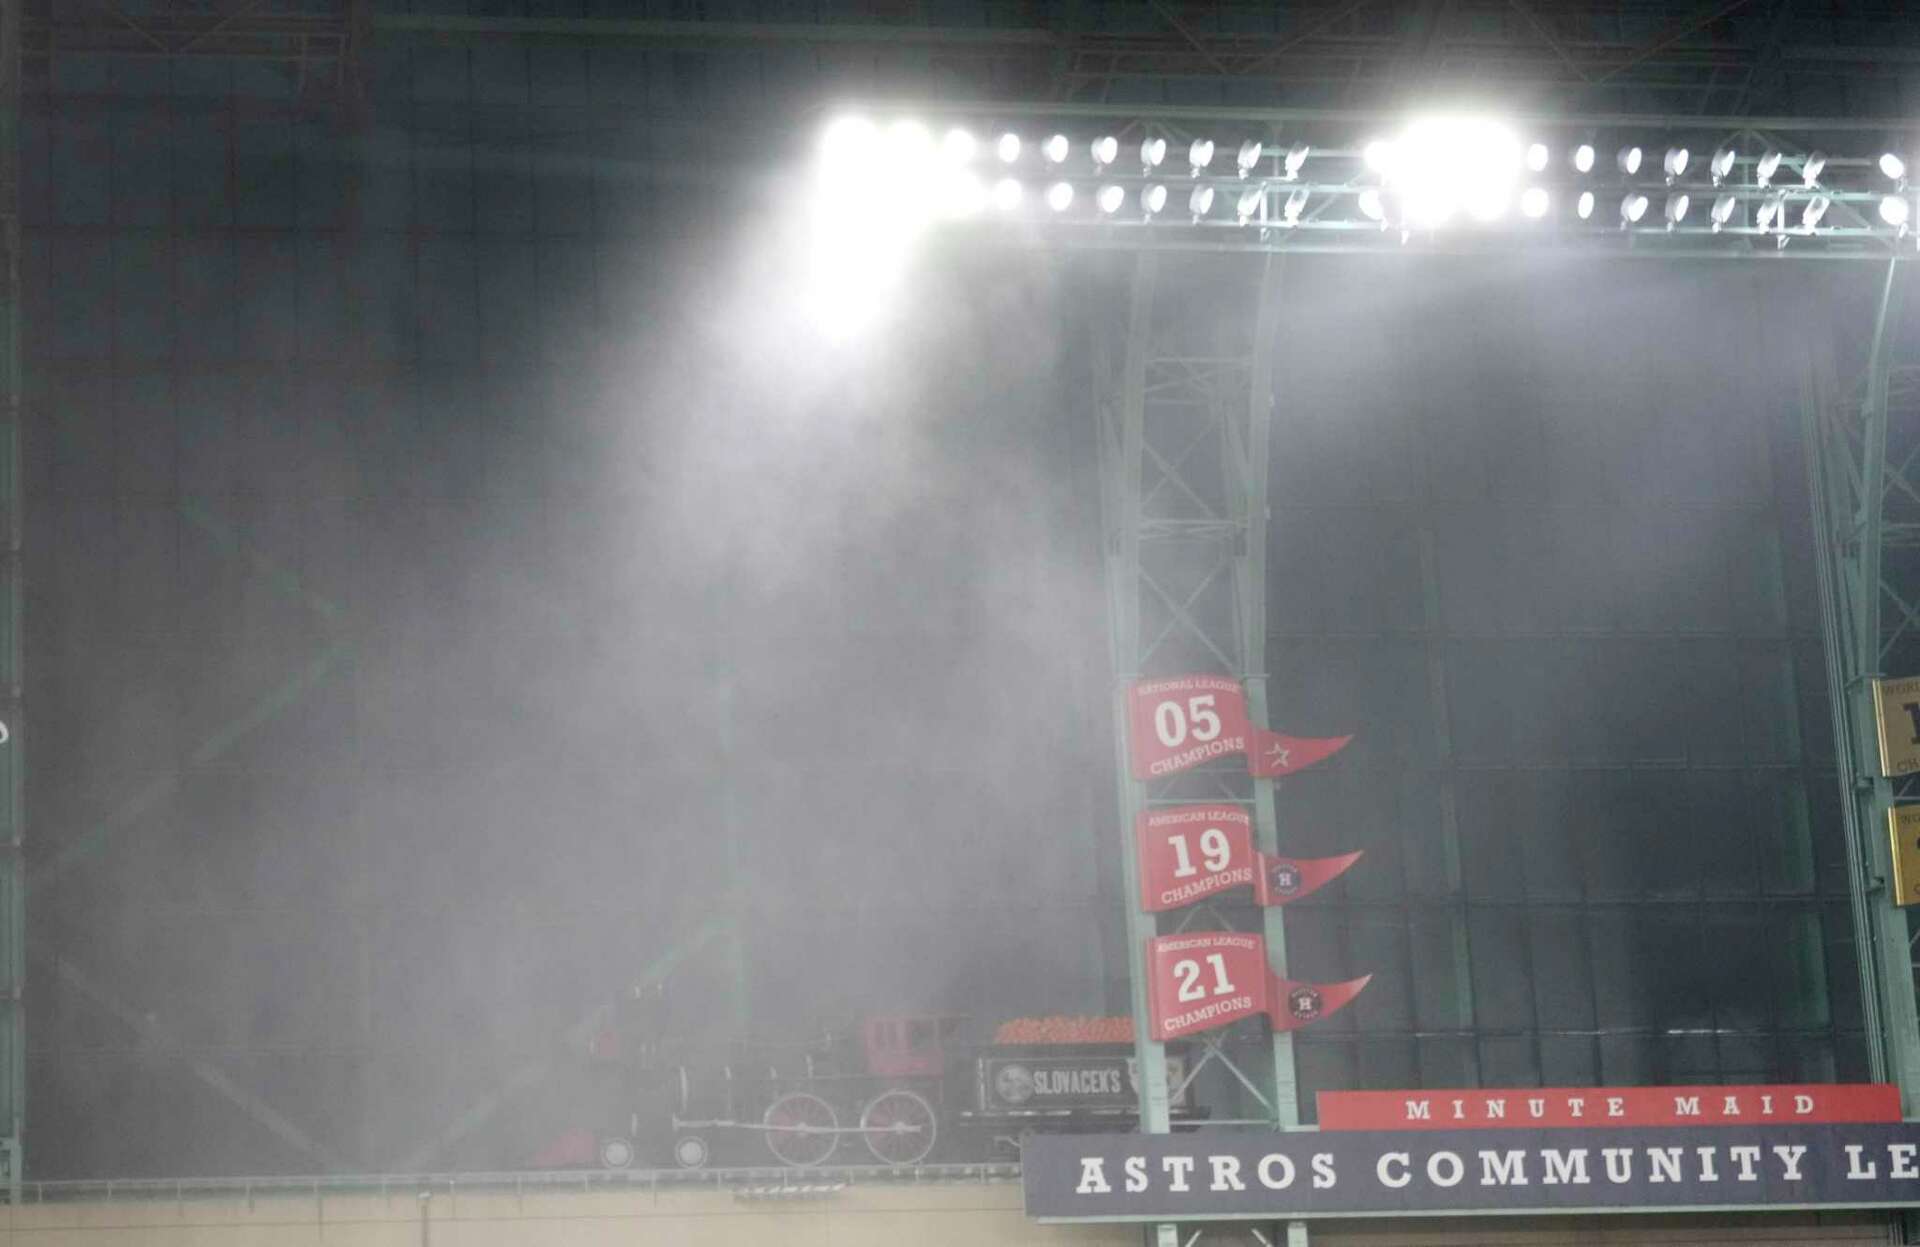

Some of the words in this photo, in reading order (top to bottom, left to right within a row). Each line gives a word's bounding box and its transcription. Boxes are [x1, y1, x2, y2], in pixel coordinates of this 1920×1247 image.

[1195, 679, 1241, 693] LEAGUE
[1154, 695, 1221, 748] 05
[1150, 737, 1245, 775] CHAMPIONS
[1148, 811, 1206, 826] AMERICAN
[1207, 810, 1249, 824] LEAGUE
[1167, 828, 1231, 878] 19
[1161, 867, 1252, 904] CHAMPIONS
[1156, 937, 1212, 952] AMERICAN
[1213, 936, 1255, 949] LEAGUE
[1173, 953, 1235, 1003] 21
[1163, 996, 1252, 1031] CHAMPIONS
[1033, 1070, 1121, 1095] SLOVACEK'S
[1406, 1098, 1624, 1120] MINUTE
[1675, 1095, 1815, 1116] MAID
[1075, 1153, 1337, 1194] ASTROS
[1376, 1145, 1807, 1188] COMMUNITY
